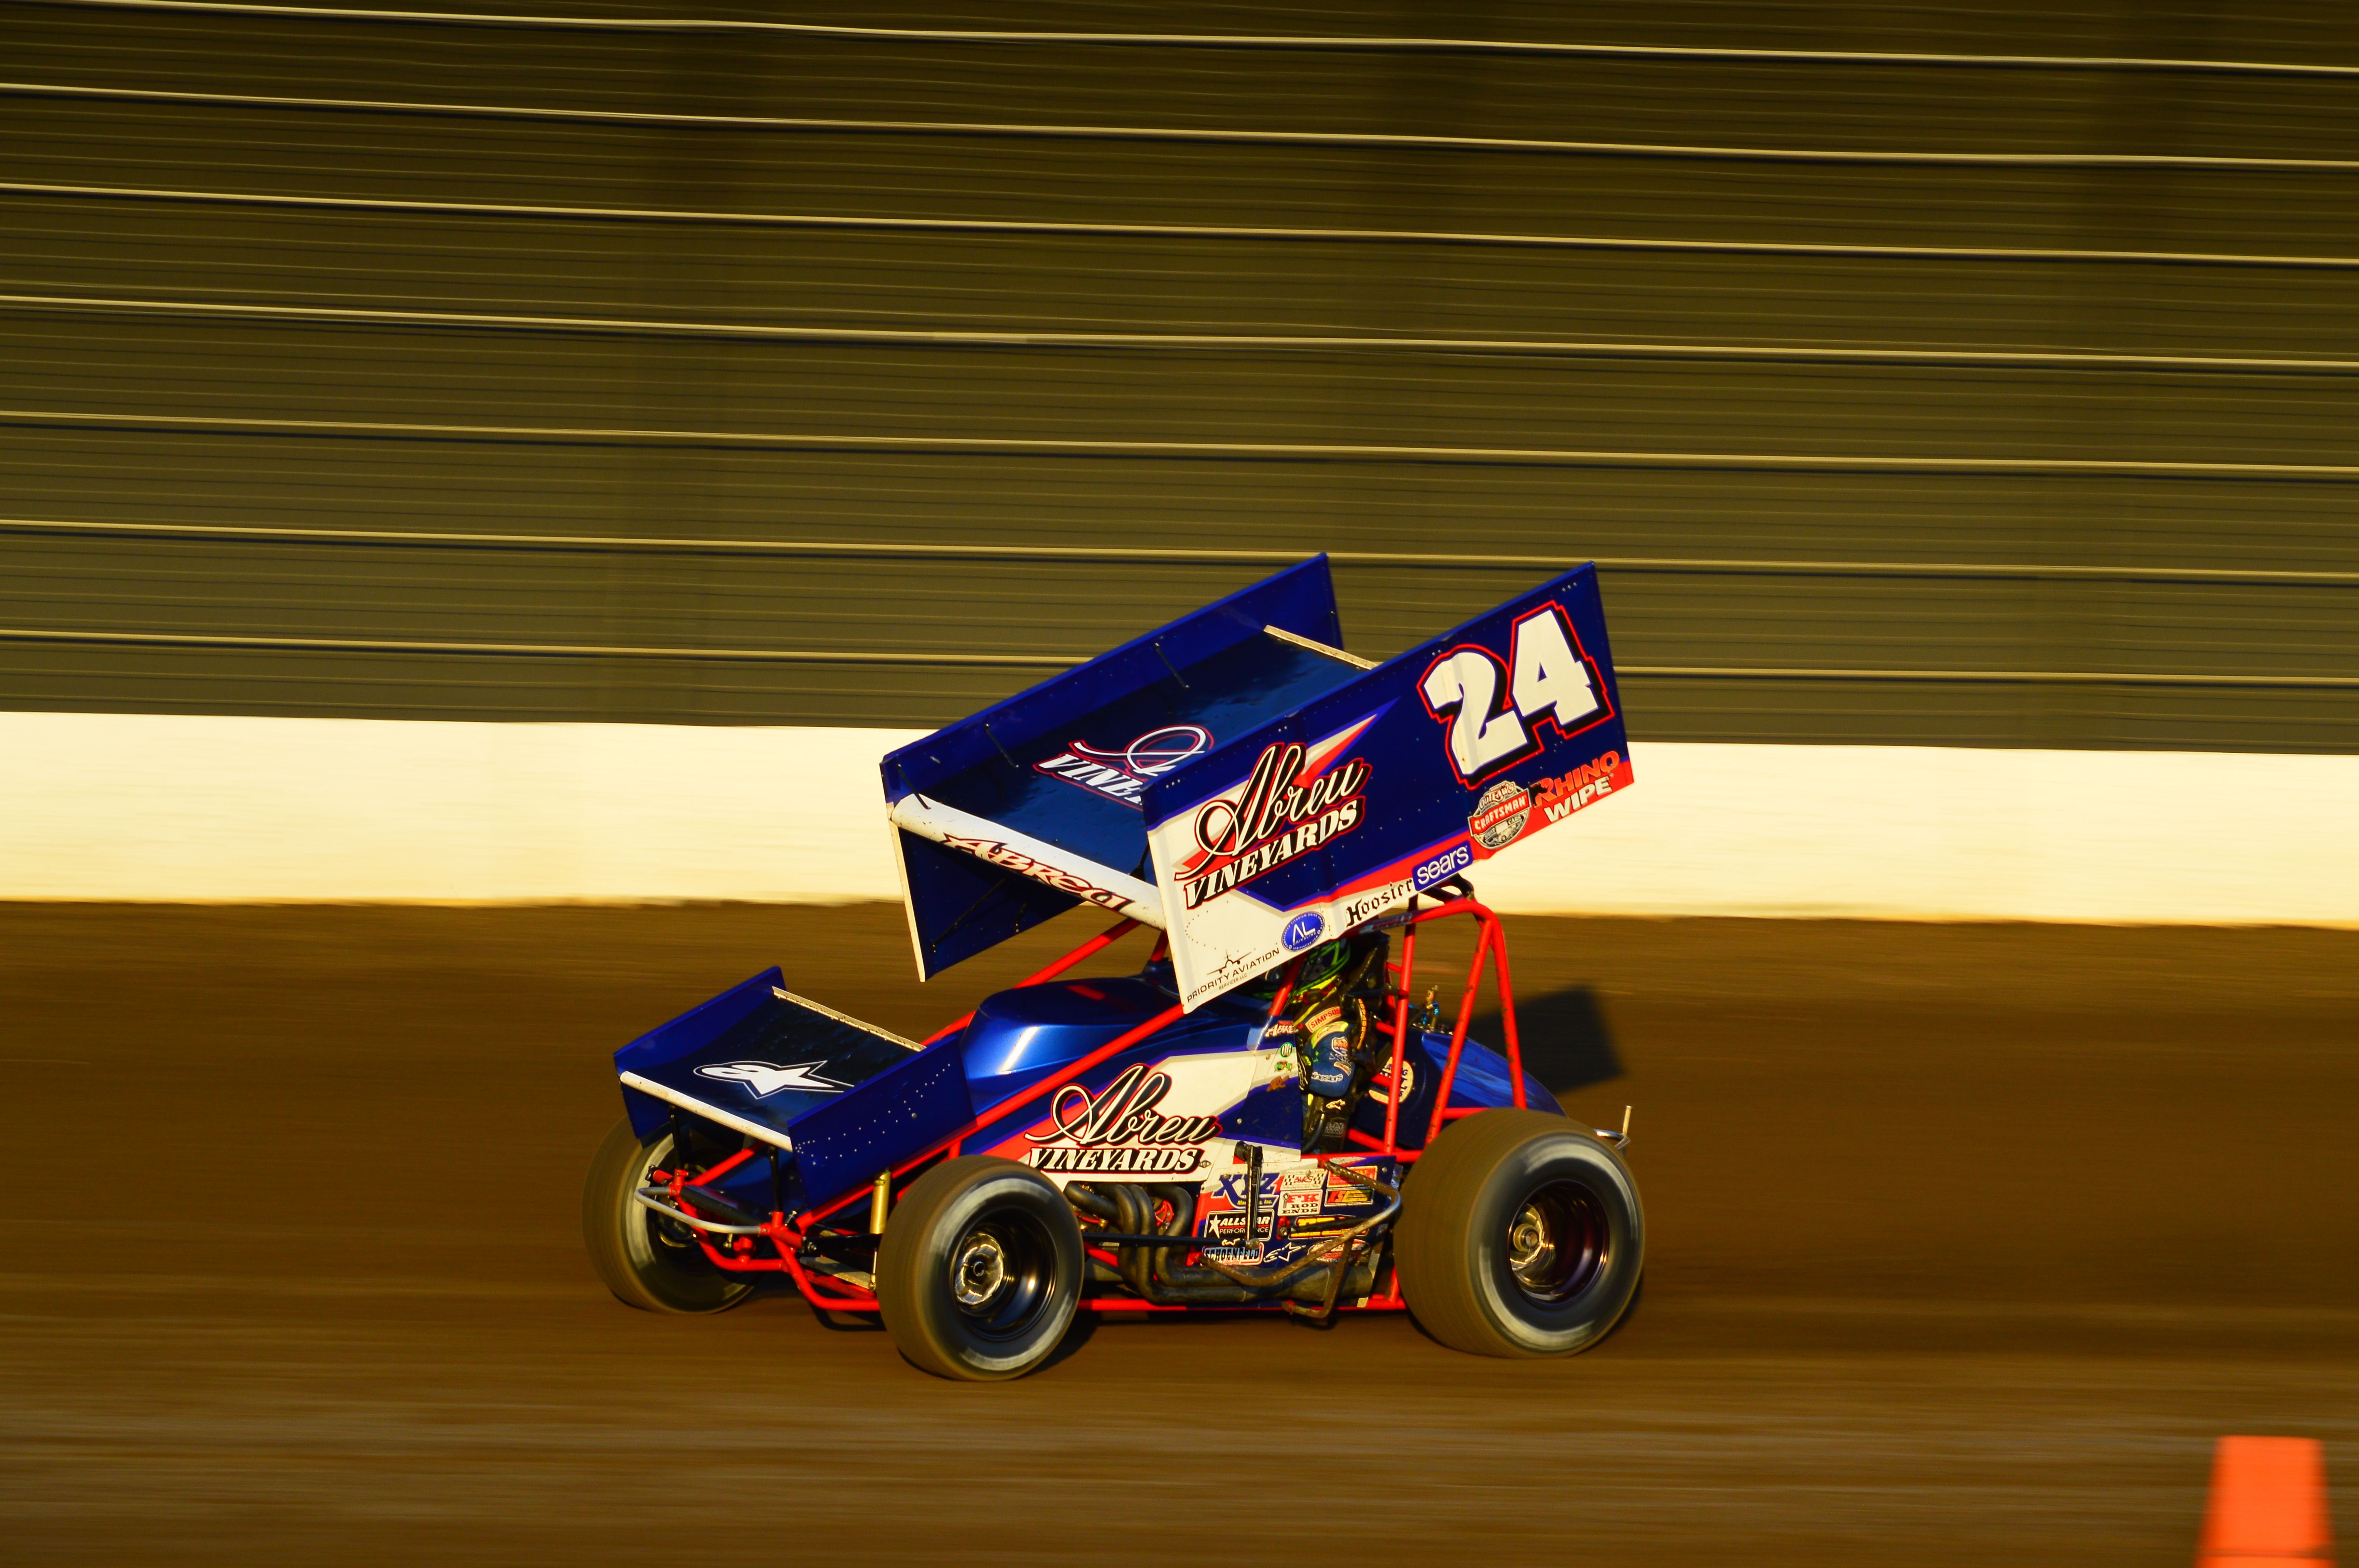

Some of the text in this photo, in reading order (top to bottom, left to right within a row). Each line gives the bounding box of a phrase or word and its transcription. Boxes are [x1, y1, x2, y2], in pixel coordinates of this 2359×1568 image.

[1420, 605, 1607, 782] 24
[1479, 784, 1515, 810] OUTLAWS
[1530, 751, 1620, 808] RHINO
[1175, 744, 1369, 880] Abreu
[1474, 795, 1527, 830] CRAFTSMAN
[1544, 776, 1612, 822] WIPE
[1508, 815, 1521, 824] CARS
[1185, 799, 1361, 908] VINEYARDS
[1417, 846, 1469, 884] sears
[1346, 878, 1412, 927] Hoosier
[1187, 947, 1279, 1003] PRIORITY AVIATION
[1219, 978, 1239, 990] SERVICES
[1310, 1007, 1341, 1029] SIMPSON
[1025, 1065, 1216, 1145] Abreu
[1029, 1148, 1199, 1171] VINEYARDS
[1287, 1194, 1319, 1203] FK
[1219, 1216, 1270, 1227] ALLSAR
